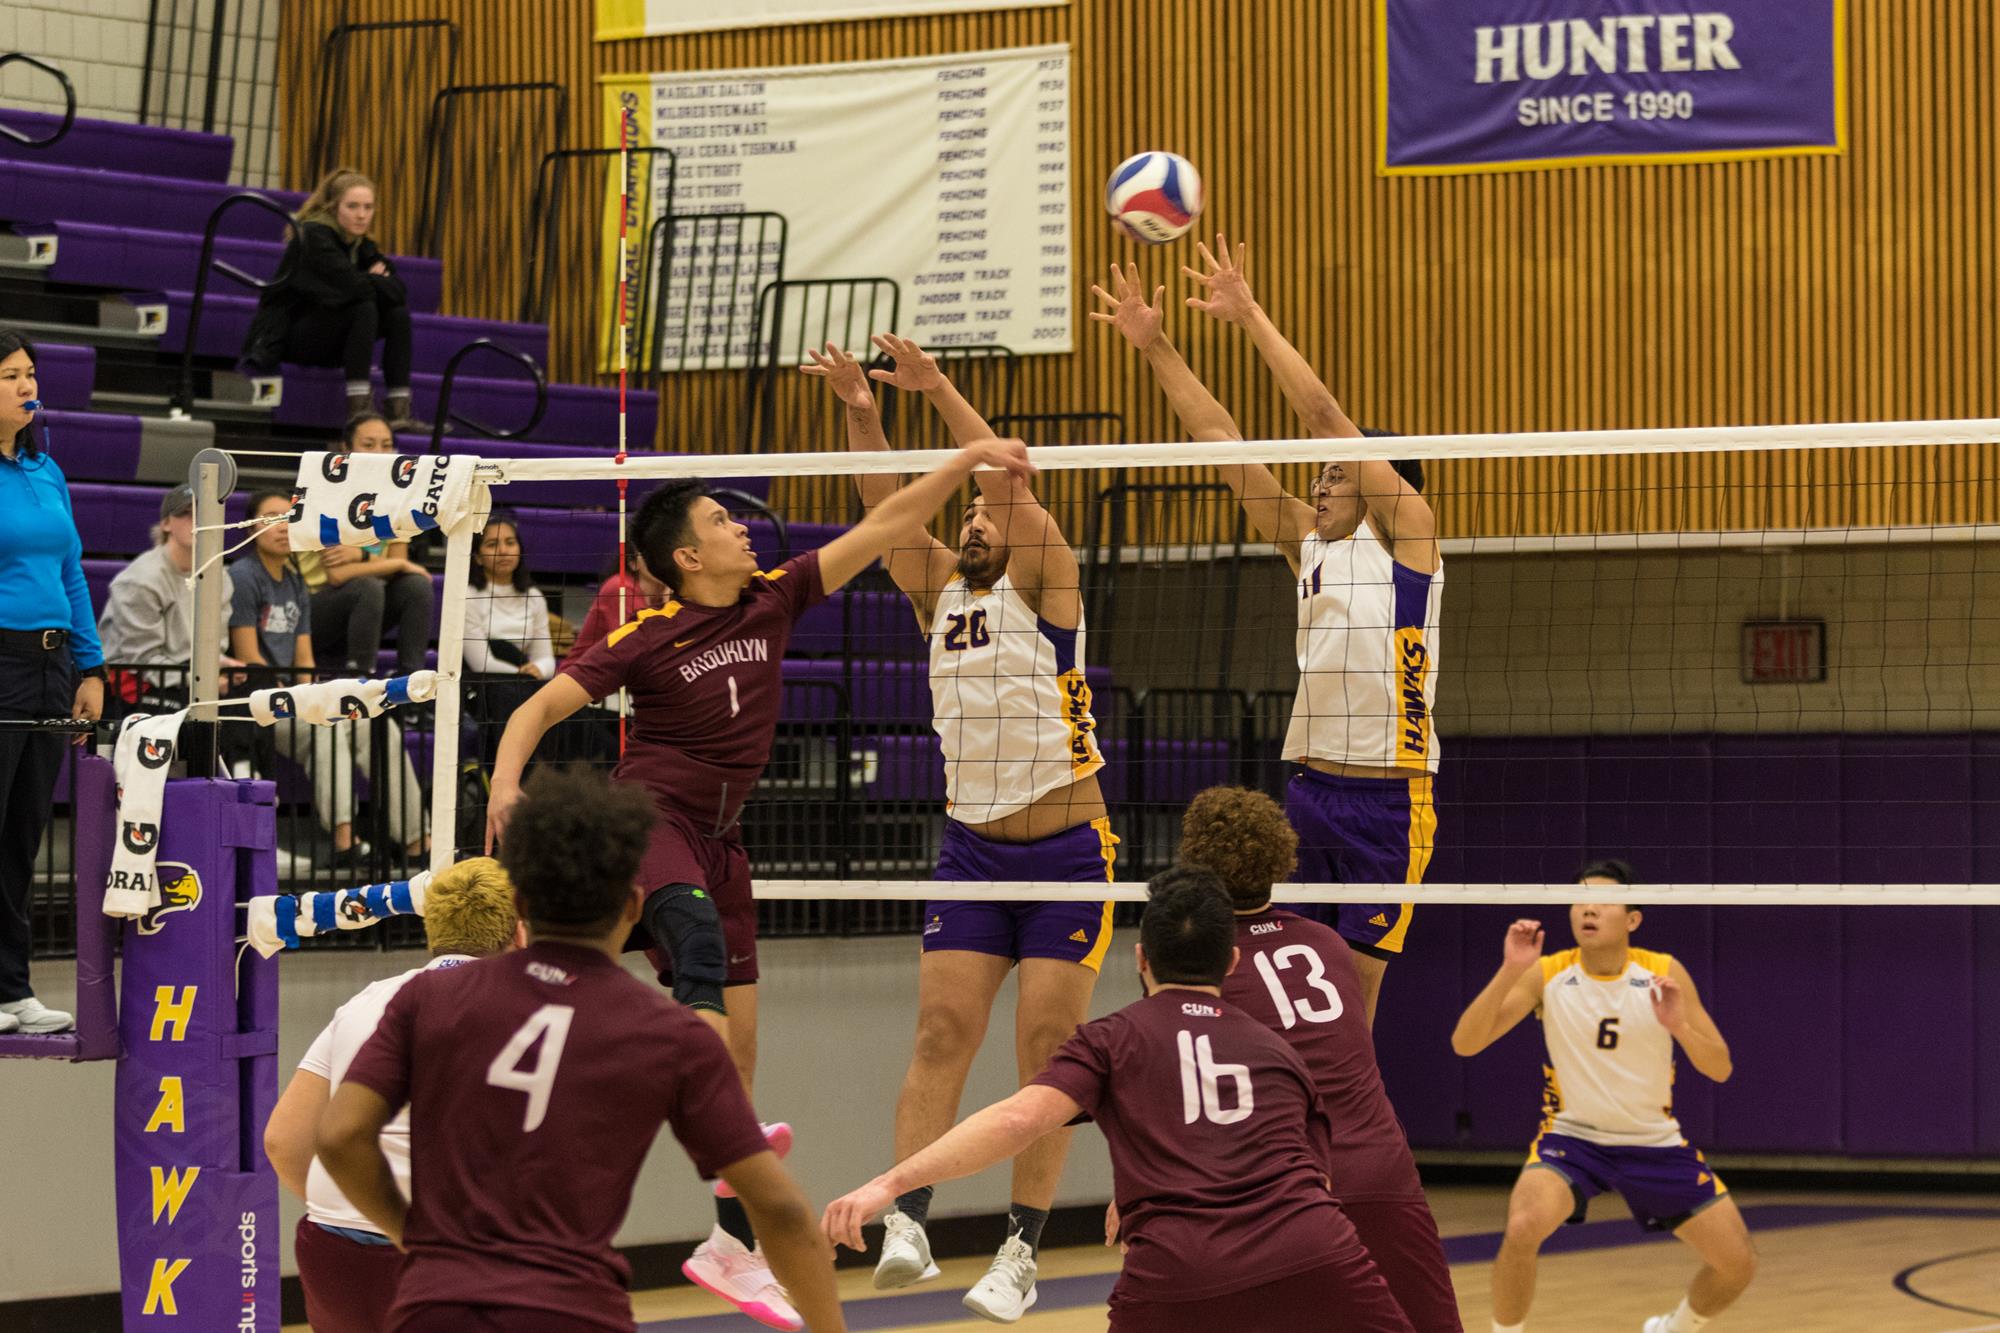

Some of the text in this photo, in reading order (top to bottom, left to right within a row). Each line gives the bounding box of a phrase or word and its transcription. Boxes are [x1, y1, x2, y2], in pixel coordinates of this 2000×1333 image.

[1474, 13, 1742, 84] HUNTER
[937, 68, 986, 81] FENCING
[657, 105, 706, 121] MILDRED
[710, 103, 766, 117] STEWART
[939, 88, 987, 101] FENCING
[1518, 90, 1693, 127] SINCE 1990
[657, 125, 706, 140] MILDRED
[710, 122, 767, 137] STEWART
[939, 108, 986, 121] FENCING
[940, 128, 987, 140] FENCING
[938, 149, 986, 162] FENCING
[940, 169, 987, 181] FENCING
[940, 189, 987, 200] FENCING
[938, 209, 986, 222] FENCING
[938, 229, 987, 243] FENCING
[939, 250, 987, 262] FENCING
[914, 272, 966, 285] OUTDOOR
[974, 269, 1011, 281] TRACK
[919, 292, 961, 305] INDOOR
[971, 290, 1007, 300] TRACK
[914, 312, 966, 326] OUTDOOR
[975, 310, 1012, 322] TRACK
[931, 328, 1065, 345] WRESTLING 2007
[945, 608, 990, 651] 20
[679, 638, 768, 683] BROOKLYN
[727, 675, 740, 718] 1
[1403, 638, 1427, 755] HAWKS
[1253, 944, 1344, 1031] 13
[1596, 1018, 1620, 1050] 6
[486, 1003, 575, 1133] 4
[1177, 1029, 1254, 1126] 16
[238, 1211, 258, 1289] sports
